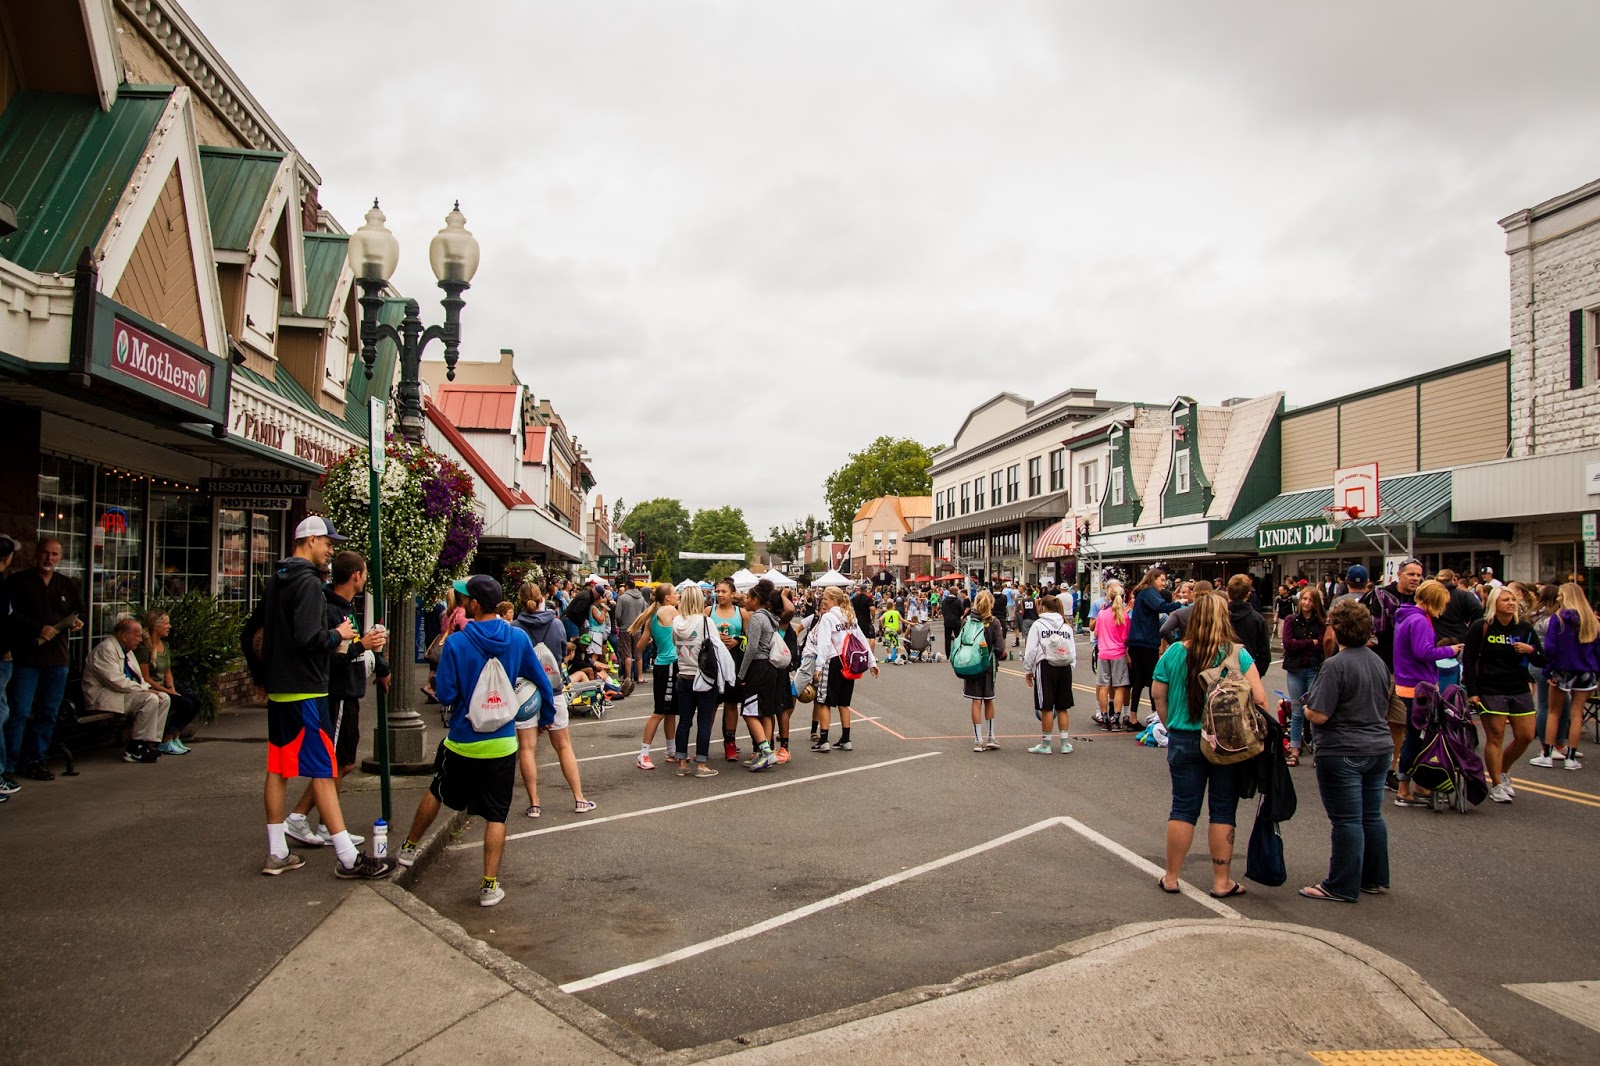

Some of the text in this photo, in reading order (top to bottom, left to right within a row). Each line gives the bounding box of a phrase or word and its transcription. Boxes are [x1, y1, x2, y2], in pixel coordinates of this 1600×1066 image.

[129, 336, 197, 394] Mothers
[244, 413, 285, 450] FAMILY
[229, 468, 281, 478] DUTCH
[207, 482, 303, 494] RESTAURANT
[221, 498, 289, 508] MOTHERS
[100, 513, 127, 534] OPEN
[1258, 524, 1336, 549] LYNDEN BOLT
[1386, 560, 1394, 575] 12
[888, 615, 894, 624] 4
[1487, 634, 1523, 645] adida
